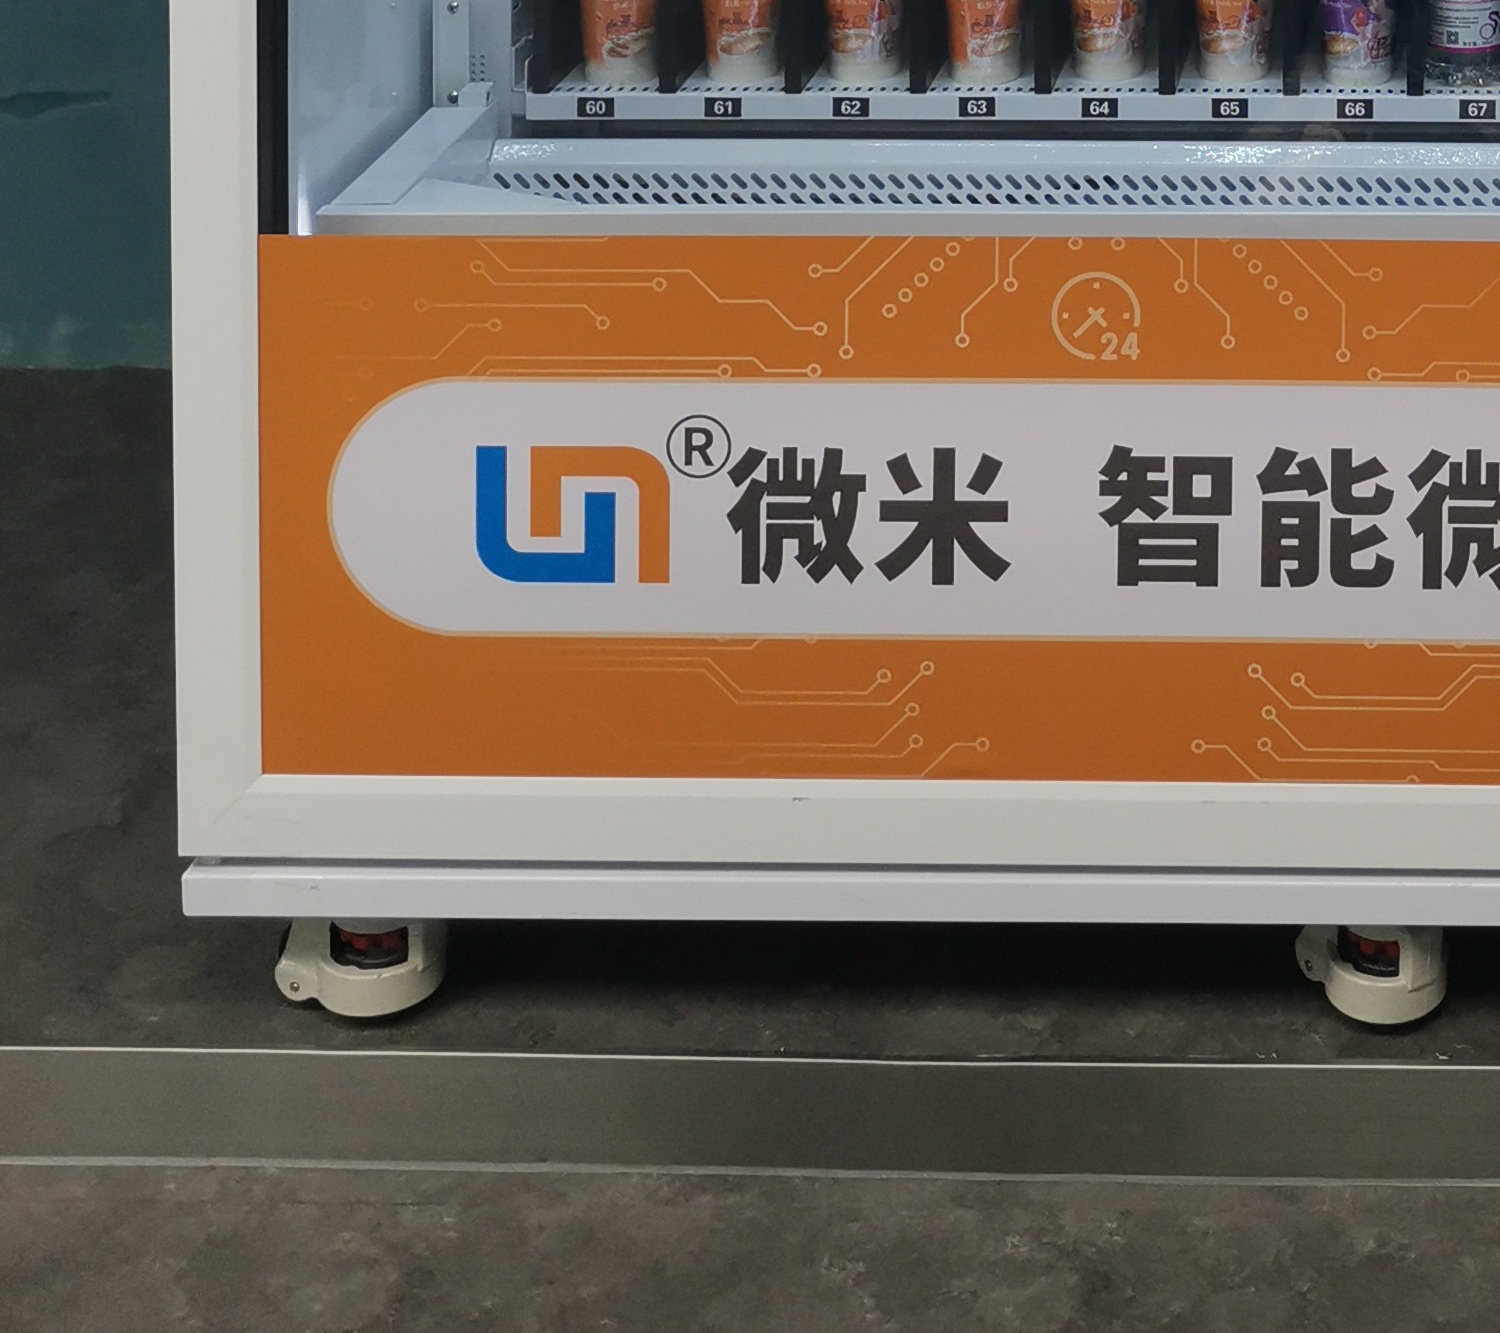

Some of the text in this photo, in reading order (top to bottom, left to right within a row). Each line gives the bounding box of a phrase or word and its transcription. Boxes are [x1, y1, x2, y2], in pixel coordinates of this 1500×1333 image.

[585, 100, 606, 115] 60
[713, 100, 733, 115] 61
[840, 100, 861, 115] 62
[967, 99, 987, 115] 63
[1089, 100, 1110, 116] 64
[1219, 101, 1240, 116] 65
[1344, 101, 1366, 117] 66
[1467, 102, 1488, 117] 67
[1099, 330, 1141, 362] 24
[727, 443, 1012, 587] 微米
